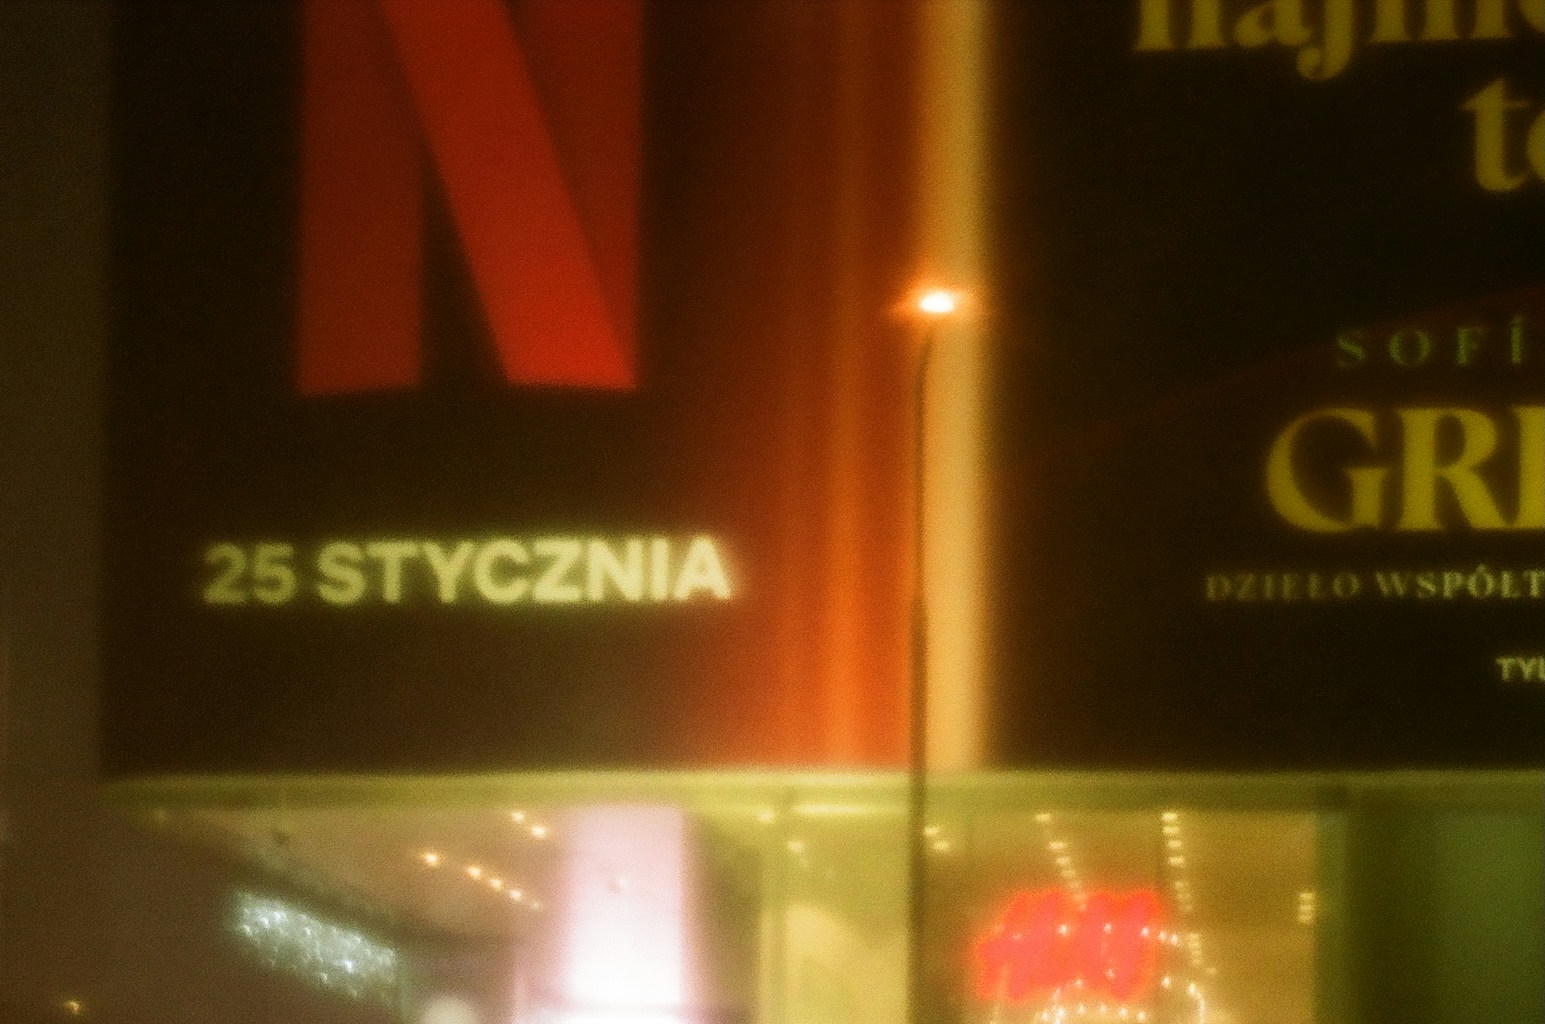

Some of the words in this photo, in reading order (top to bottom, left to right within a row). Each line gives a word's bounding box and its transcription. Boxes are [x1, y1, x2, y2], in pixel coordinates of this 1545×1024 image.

[296, 0, 642, 392] N
[204, 542, 297, 604] 25
[317, 536, 732, 603] STYCZNIA
